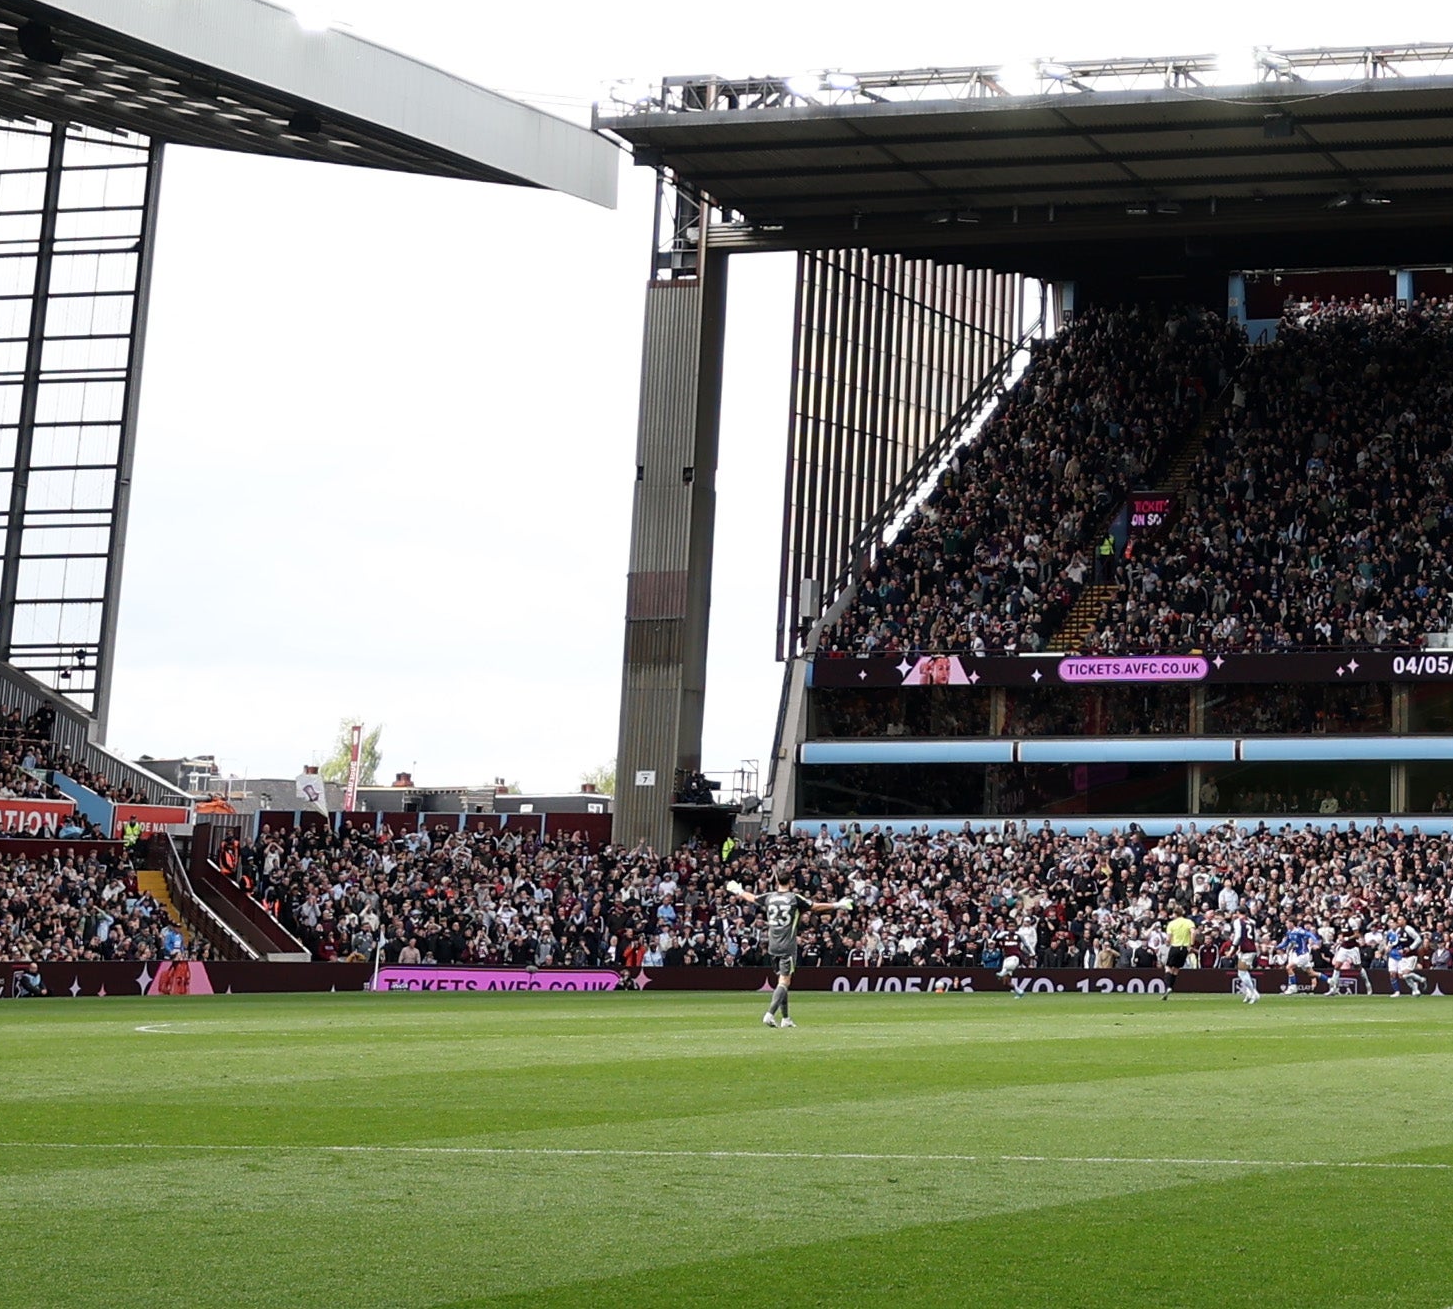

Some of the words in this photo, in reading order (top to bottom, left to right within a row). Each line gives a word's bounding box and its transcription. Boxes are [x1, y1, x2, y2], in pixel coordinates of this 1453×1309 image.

[1131, 513, 1145, 527] ON
[1068, 662, 1200, 676] TICKETS.AVFC.CO.UK
[768, 904, 792, 926] 23
[1246, 924, 1253, 939] 2
[384, 978, 612, 992] TICKETSAVFCCOUK
